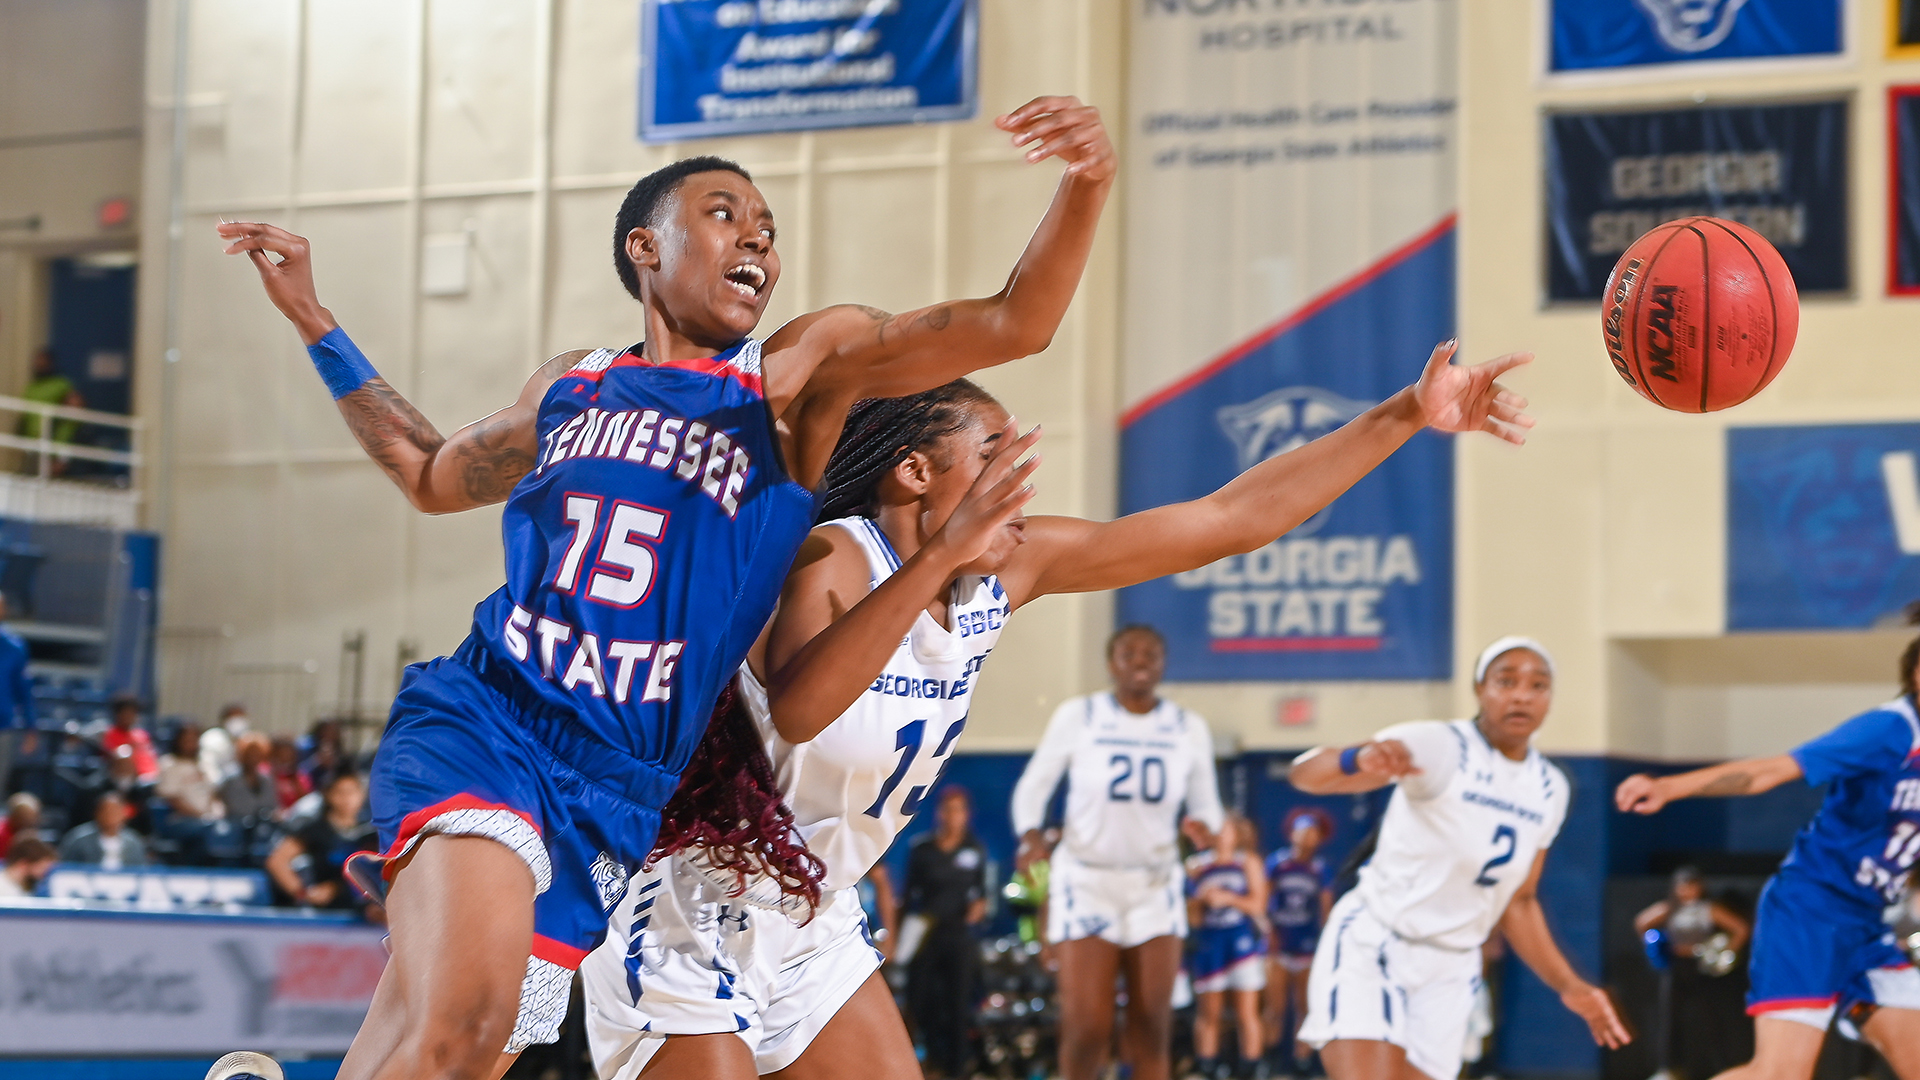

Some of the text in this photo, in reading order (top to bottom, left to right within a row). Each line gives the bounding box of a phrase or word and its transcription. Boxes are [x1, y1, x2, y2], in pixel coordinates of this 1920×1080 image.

[735, 29, 829, 62] Award
[1201, 14, 1401, 50] HOSPITAL
[721, 53, 894, 92] Institutional
[698, 86, 917, 121] Transformation
[1142, 110, 1221, 135] Official
[1229, 106, 1299, 127] Health
[1308, 103, 1358, 125] Care
[1188, 143, 1275, 173] Georgia
[1284, 138, 1338, 159] State
[1614, 154, 1779, 198] GEORGIA
[1603, 256, 1645, 386] Wilson
[1647, 284, 1679, 384] NCAA
[536, 407, 751, 521] TENNESSEE
[553, 491, 671, 610] 15
[1208, 587, 1384, 638] STATE
[504, 603, 686, 704] STATE
[869, 672, 969, 700] GEORGIA
[1109, 754, 1167, 804] 20
[1474, 824, 1517, 889] 2
